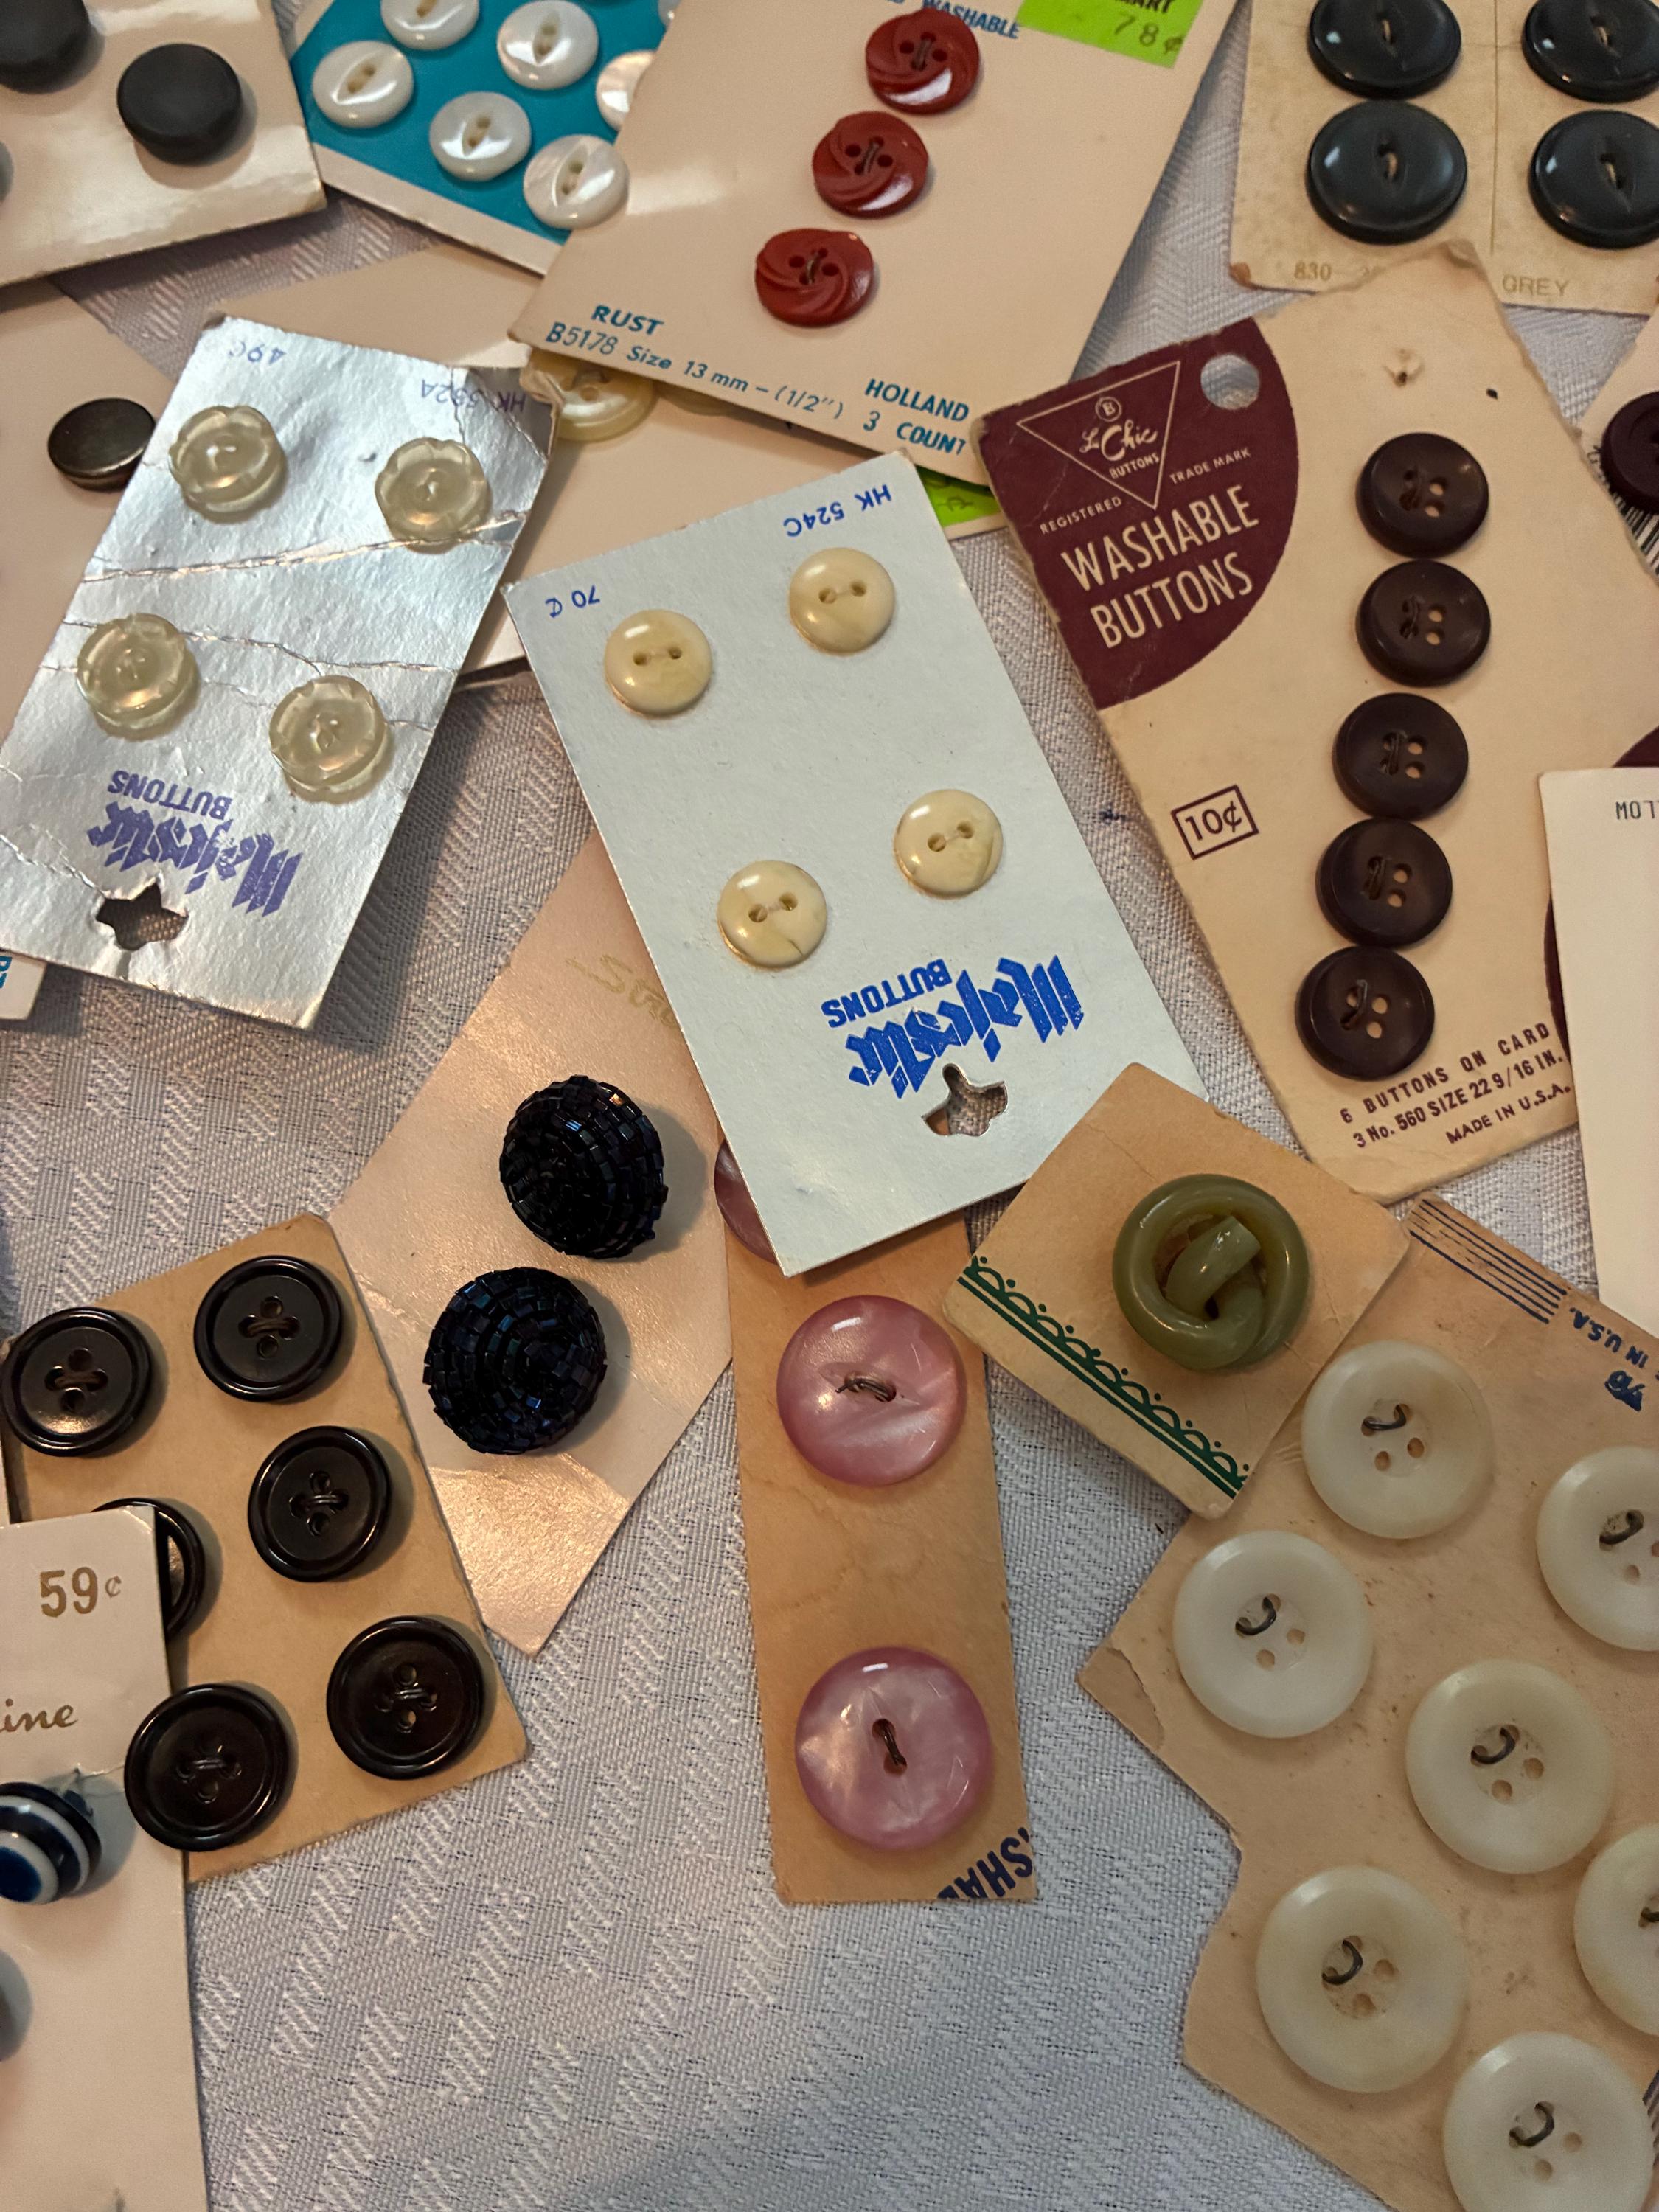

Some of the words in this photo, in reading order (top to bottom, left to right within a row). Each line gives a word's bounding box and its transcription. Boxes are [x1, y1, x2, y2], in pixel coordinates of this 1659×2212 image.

[1294, 261, 1332, 282] 830
[1502, 274, 1569, 296] GREY
[591, 305, 664, 335] RUST
[546, 322, 618, 355] B5178
[627, 345, 672, 369] Size
[684, 360, 708, 378] 13
[710, 370, 749, 392] mm
[864, 378, 969, 422] HOLLAND
[863, 410, 880, 431] 3
[896, 422, 967, 456] COUNT
[1109, 452, 1159, 479] BUTTONS
[854, 484, 891, 512] HK
[1040, 495, 1122, 535] REGISTERED
[1169, 461, 1211, 484] TRADE
[1213, 447, 1251, 469] MARK
[783, 501, 844, 538] 524C
[1060, 484, 1259, 591] WASHABLE
[1090, 552, 1253, 649] BUTTONS
[108, 770, 233, 821] BUTTONS
[1615, 799, 1659, 819] MOT
[1185, 801, 1242, 841] 10¢
[821, 959, 953, 1029] BUTTONS
[845, 955, 1085, 1099] Majestic
[1340, 1107, 1353, 1124] 6
[1362, 1066, 1450, 1114] BUTTONS
[1459, 1049, 1486, 1073] ON
[1497, 1022, 1550, 1056] CARD
[1352, 1132, 1366, 1148] 3
[1394, 1107, 1427, 1131] 560
[1427, 1088, 1469, 1118] SIZE
[1534, 1048, 1564, 1071] IN.
[1445, 1114, 1493, 1144] MADE
[1494, 1103, 1516, 1121] IN
[1517, 1082, 1571, 1111] U.S.A.
[1569, 1307, 1622, 1353] U.S.A.
[1625, 1345, 1649, 1368] IN
[0, 1698, 78, 1733] ine
[937, 1826, 1033, 1899] SHA
